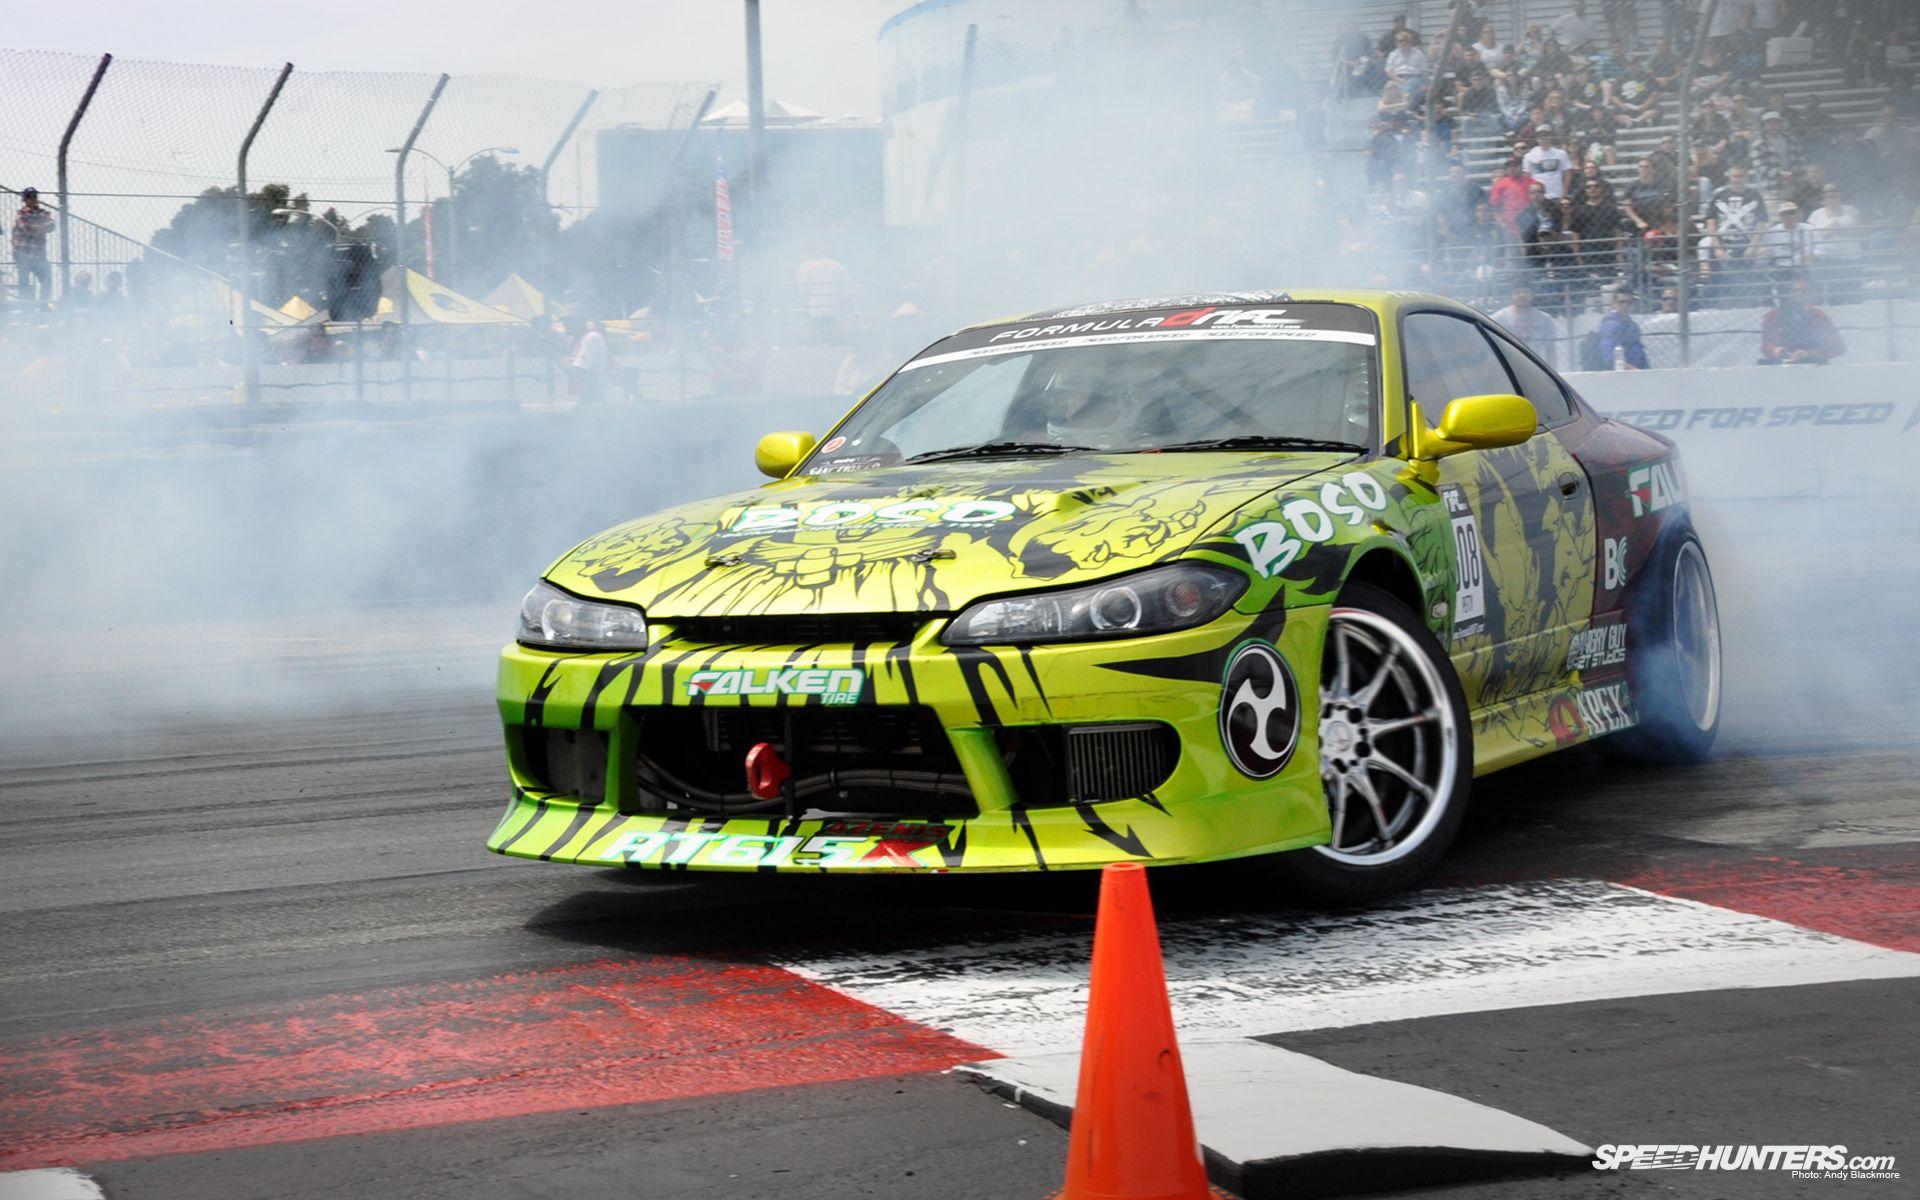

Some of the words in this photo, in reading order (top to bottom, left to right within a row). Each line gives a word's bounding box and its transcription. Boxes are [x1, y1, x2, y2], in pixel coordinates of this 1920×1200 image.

[988, 317, 1164, 343] FORMULA
[1601, 409, 1685, 431] EED
[1685, 406, 1764, 430] FOR
[1764, 402, 1896, 427] SPEED
[1628, 460, 1683, 518] FAL
[729, 500, 1016, 531] BOSO
[1232, 471, 1388, 580] BOSO
[1608, 623, 1627, 650] GUY
[687, 669, 864, 696] FALKEN
[820, 692, 857, 705] TIRE
